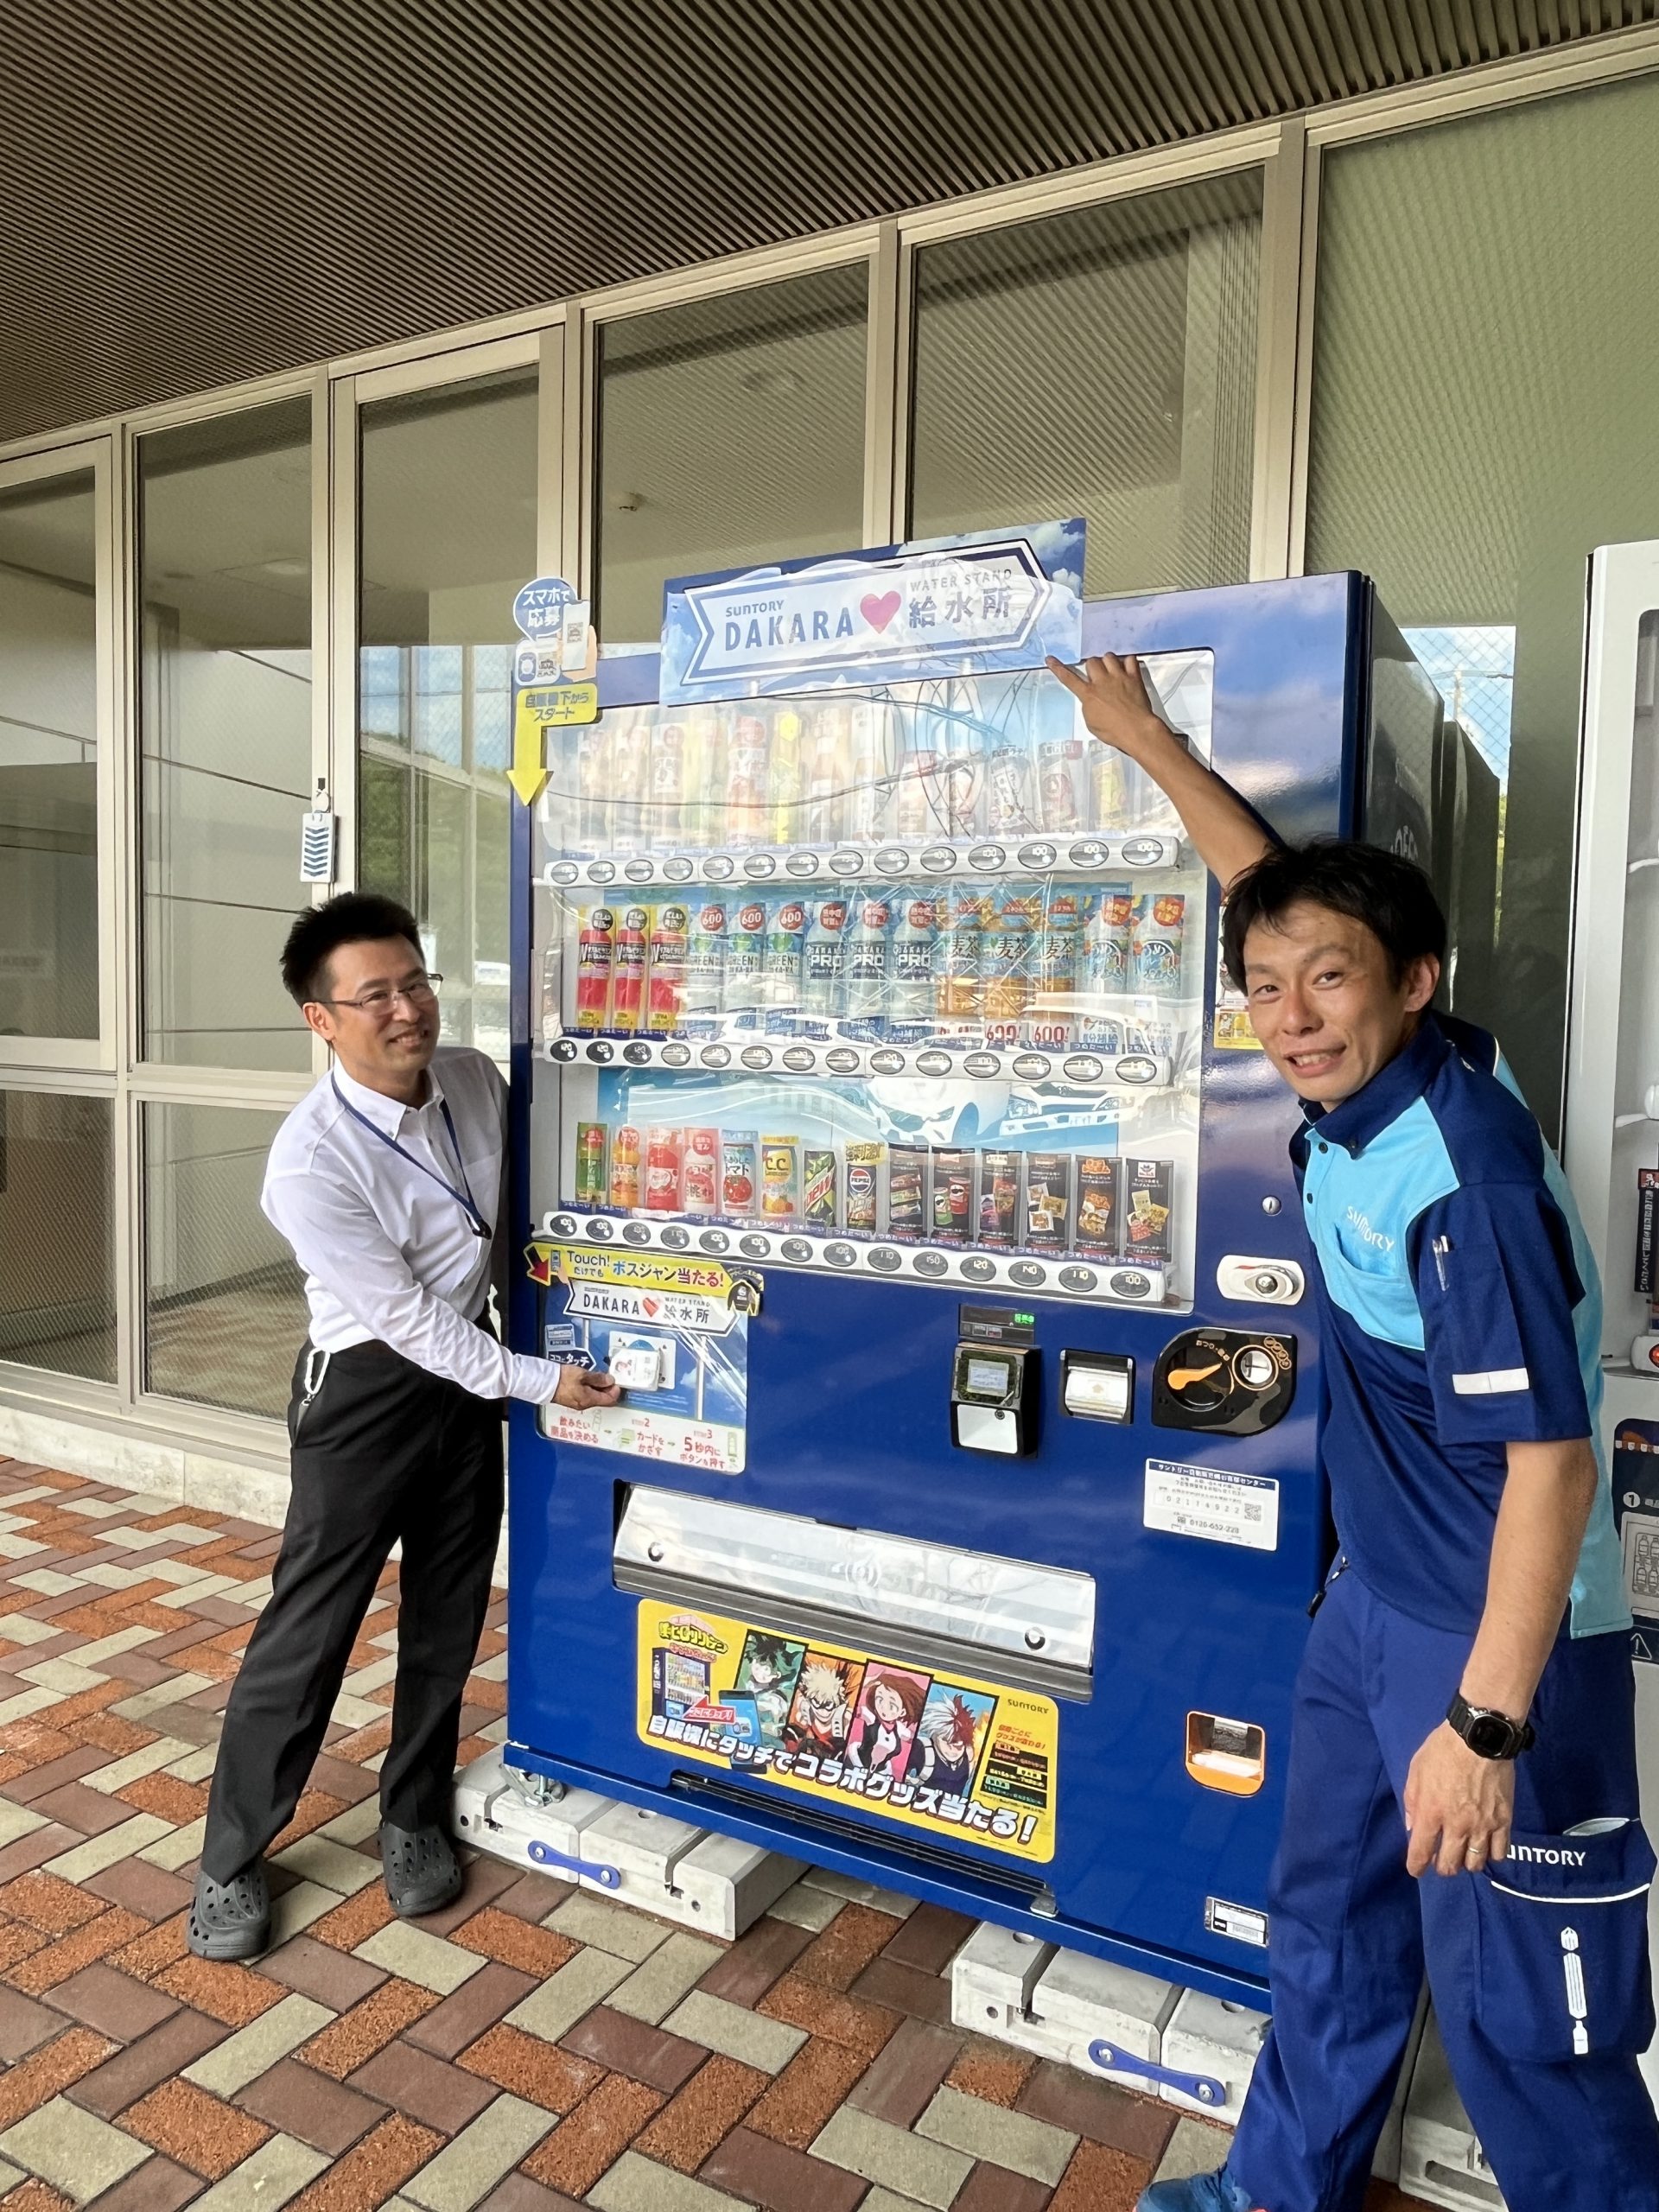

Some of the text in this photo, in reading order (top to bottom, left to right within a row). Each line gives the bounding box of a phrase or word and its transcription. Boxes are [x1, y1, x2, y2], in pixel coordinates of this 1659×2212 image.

[910, 569, 1013, 593] WATER STAND
[523, 588, 570, 606] スマホで
[725, 599, 785, 618] SUNTORY
[908, 586, 1013, 629] 給水所
[528, 605, 561, 628] 応募
[724, 607, 855, 652] DAKARA
[534, 707, 575, 722] スタート
[702, 914, 722, 925] 600
[741, 912, 761, 925] 600
[781, 911, 802, 924] 600
[810, 954, 842, 967] PRO
[854, 954, 886, 966] PRO
[898, 954, 931, 967] PRO
[726, 1164, 749, 1176] トマト
[567, 1250, 610, 1268] Touch!
[583, 1294, 640, 1315] DAKARA
[1007, 1699, 1050, 1714] SUNTORY
[1506, 1844, 1586, 1866] UNTORY
